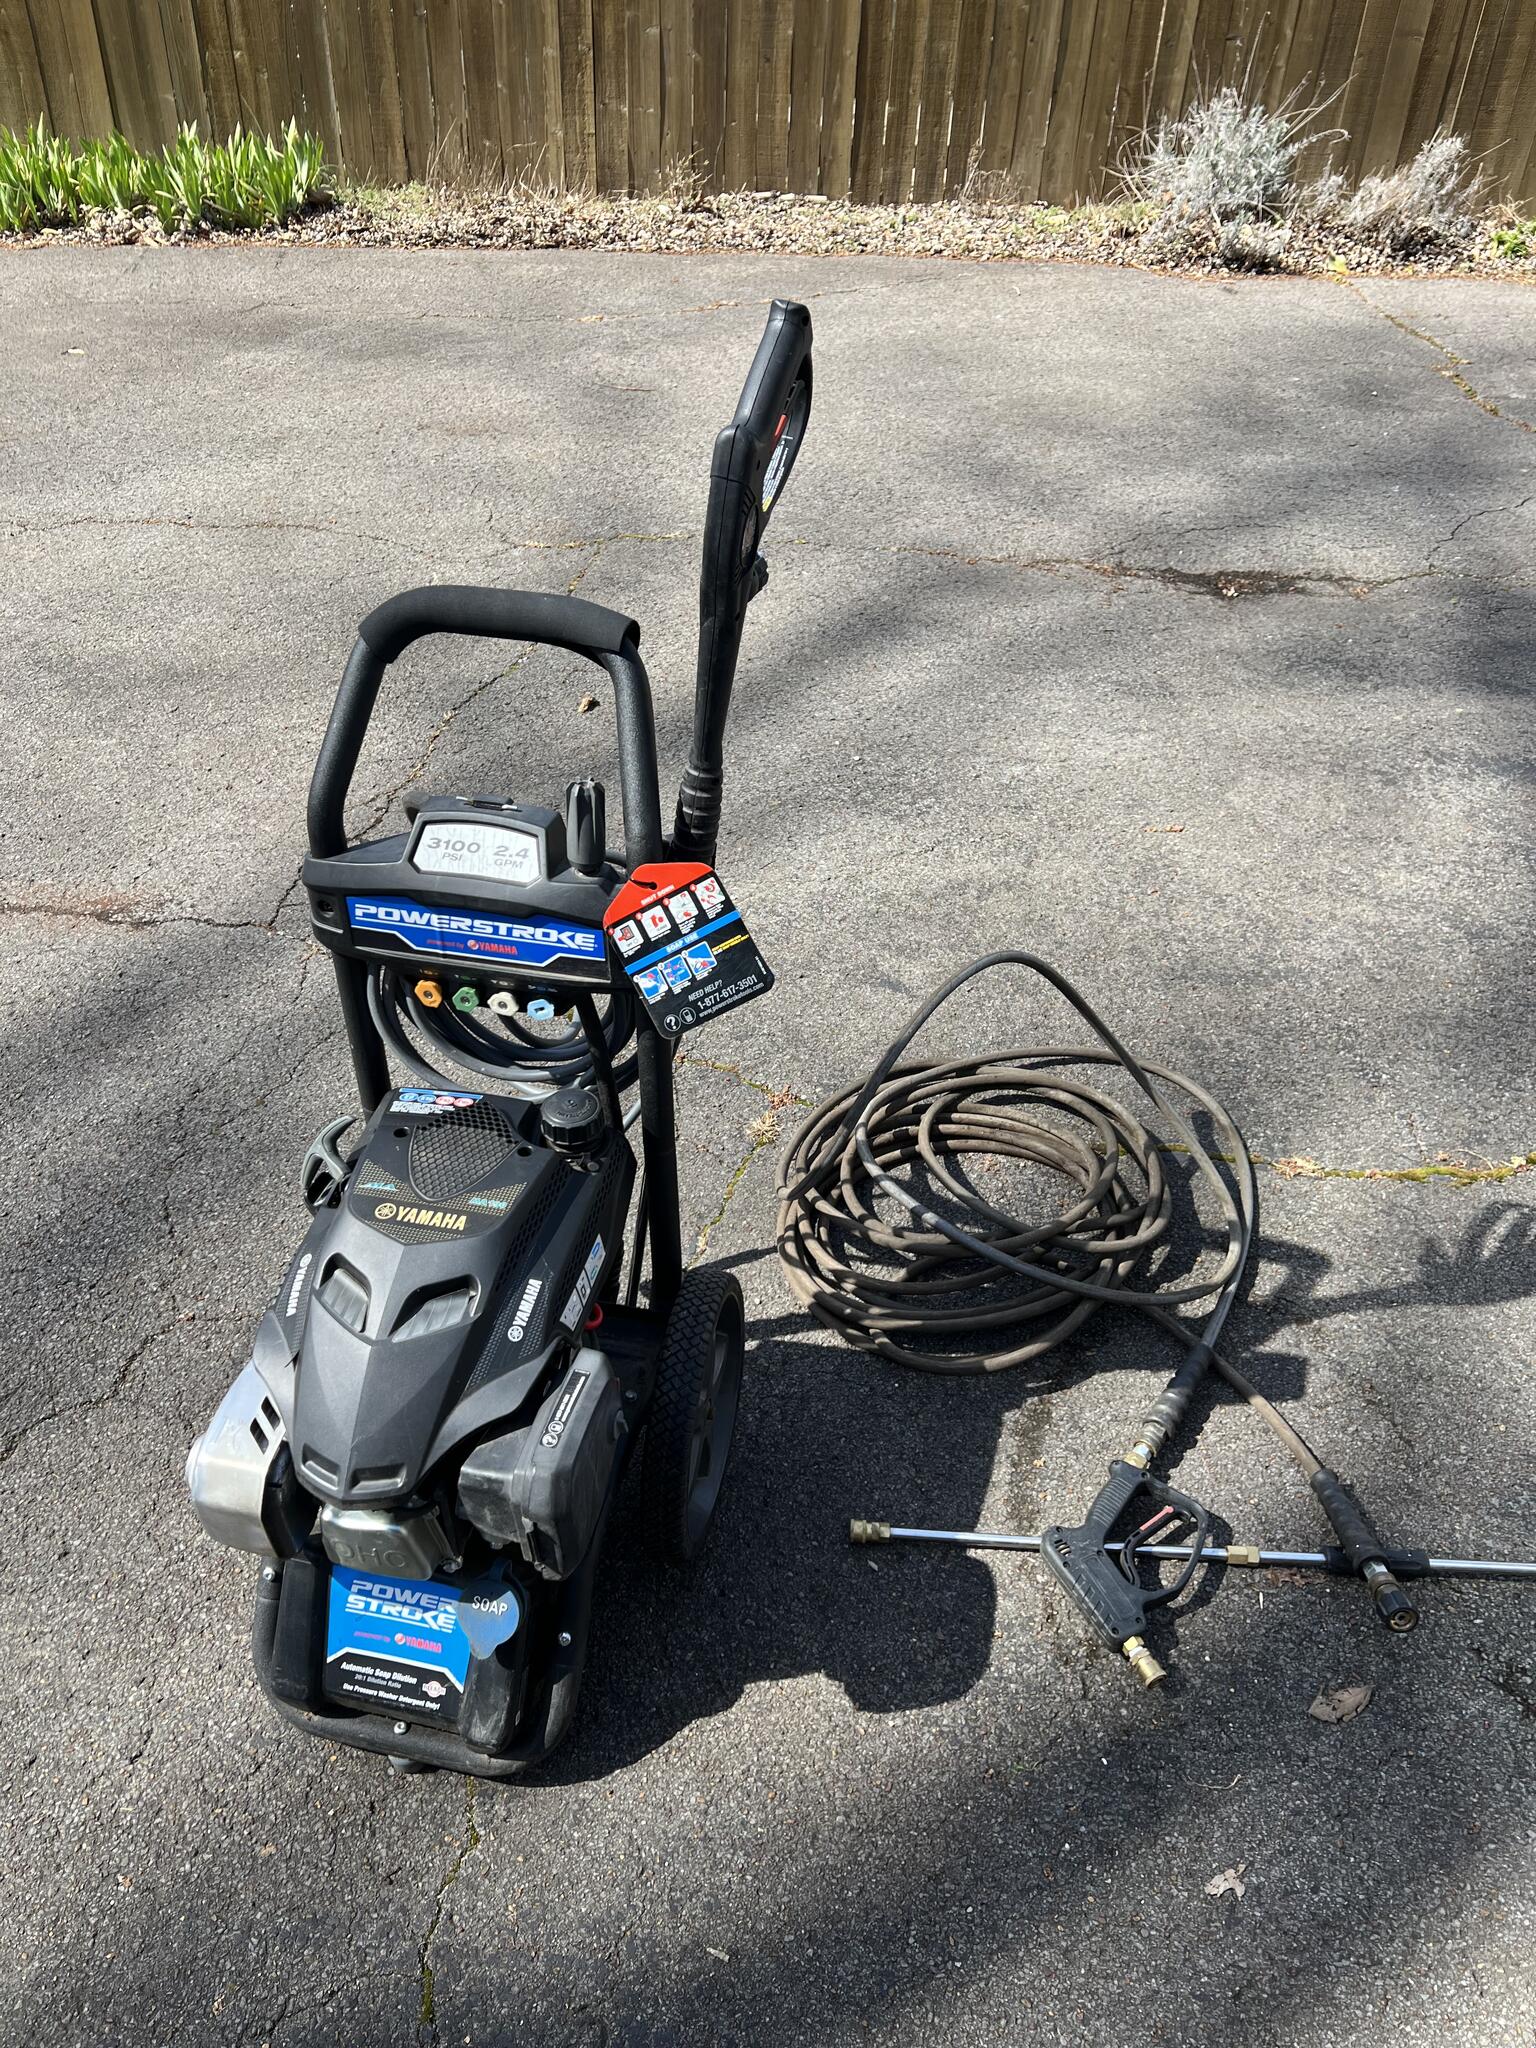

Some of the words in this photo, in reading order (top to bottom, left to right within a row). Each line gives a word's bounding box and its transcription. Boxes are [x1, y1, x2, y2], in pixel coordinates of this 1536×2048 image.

[427, 837, 481, 854] 3100
[493, 845, 530, 859] 2.4
[441, 851, 463, 862] PSI
[494, 858, 524, 869] GPM
[354, 903, 597, 950] POWERSTROKE
[479, 941, 519, 956] YAMAHA
[665, 940, 684, 953] SOAP
[684, 932, 699, 944] USE
[688, 987, 705, 1002] NEED
[704, 979, 724, 994] HELP?
[697, 975, 758, 1010] 1-877-617-3501
[396, 1205, 467, 1231] YAMAHA
[286, 1265, 308, 1317] YAMAHA
[512, 1278, 543, 1327] YAMAHA
[350, 1579, 457, 1614] POWER
[471, 1595, 508, 1616] SOAP
[345, 1594, 457, 1633] STROKE
[405, 1635, 443, 1654] YAMAHA
[340, 1661, 374, 1676] Automatic
[374, 1668, 392, 1680] Soap
[391, 1671, 418, 1685] Dilution
[387, 1680, 402, 1689] Ratio
[342, 1682, 354, 1691] Use
[353, 1685, 378, 1697] Pressure
[378, 1689, 399, 1701] Washer
[398, 1694, 426, 1707] Detergent
[425, 1699, 441, 1711] Only!
